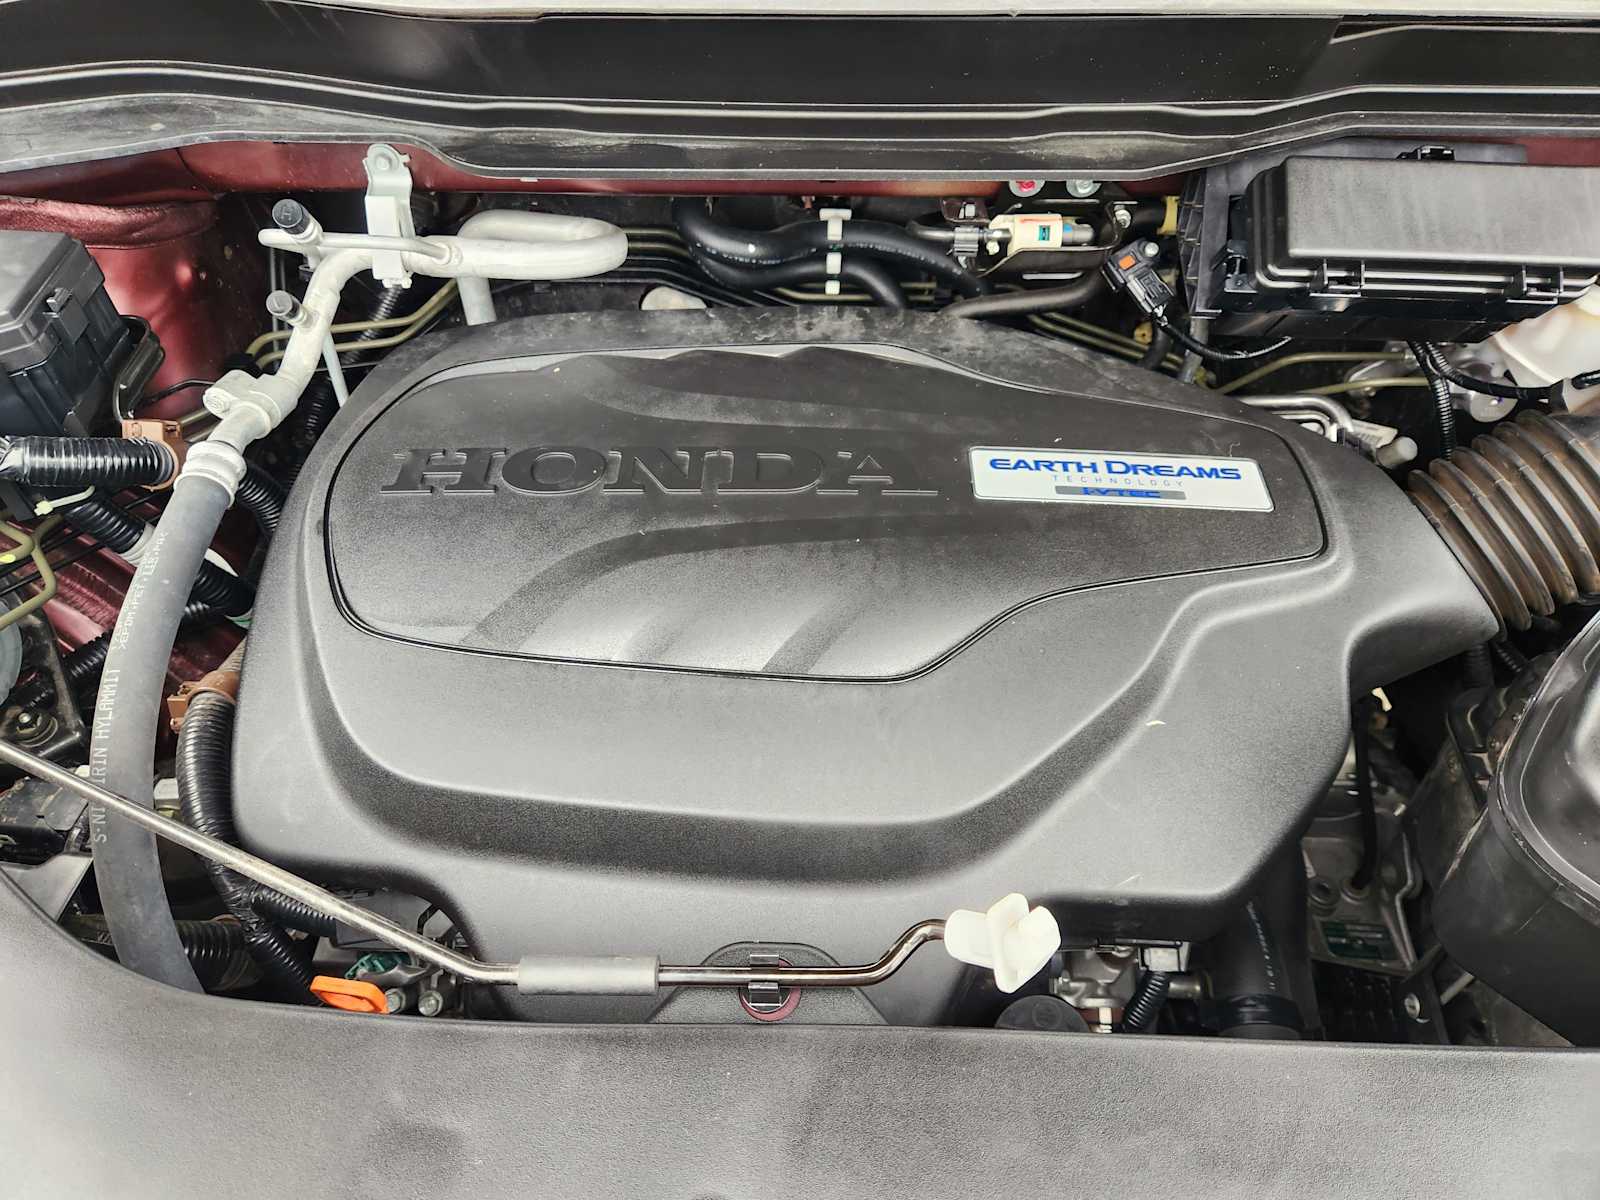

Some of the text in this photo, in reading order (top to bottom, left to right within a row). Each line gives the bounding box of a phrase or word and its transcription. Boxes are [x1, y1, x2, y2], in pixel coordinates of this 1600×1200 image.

[379, 446, 939, 496] HONDA
[989, 458, 1242, 480] EARTH DREAMS
[1052, 474, 1184, 487] TECHNOLOGY
